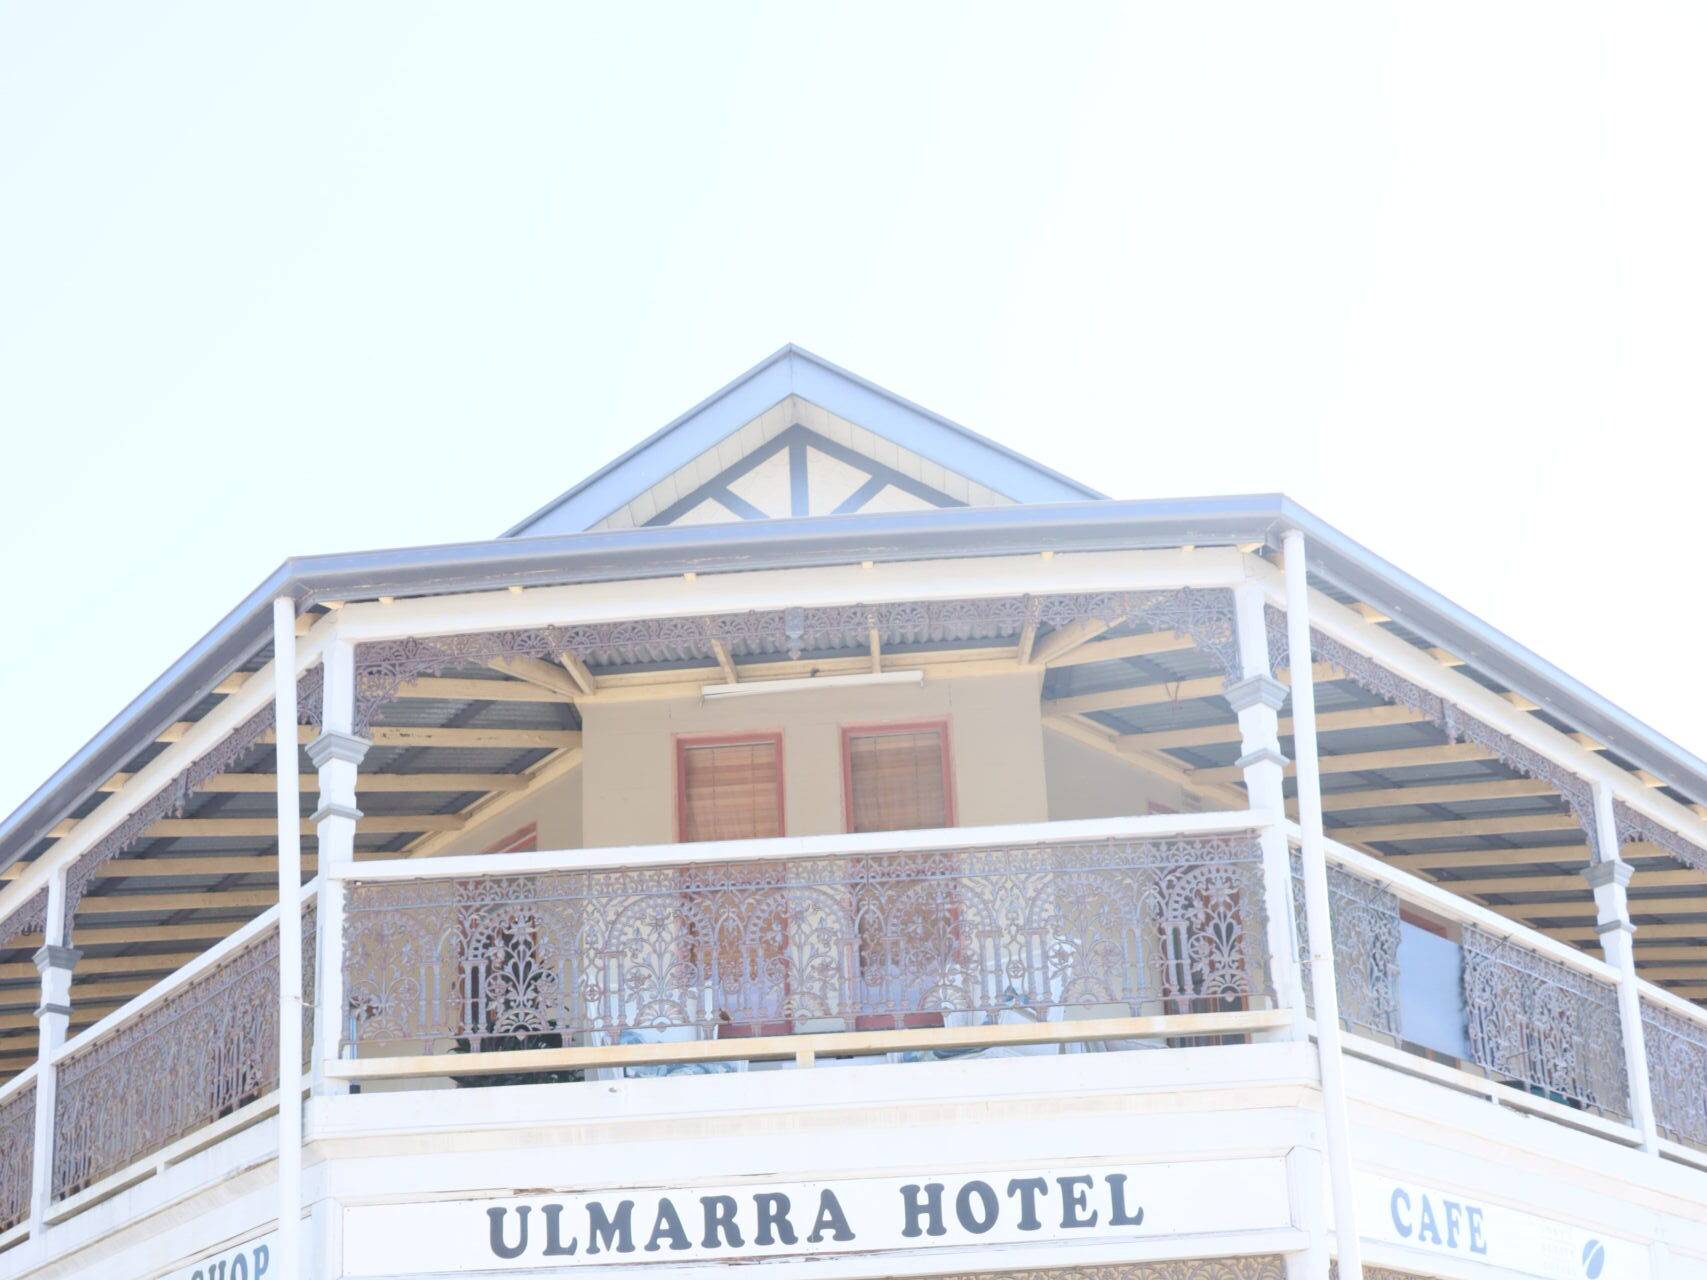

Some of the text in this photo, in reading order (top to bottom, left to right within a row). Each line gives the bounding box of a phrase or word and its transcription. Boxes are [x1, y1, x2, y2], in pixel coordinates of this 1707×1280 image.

[486, 1174, 1144, 1259] ULMARRA HOTEL
[1390, 1187, 1488, 1255] CAFE
